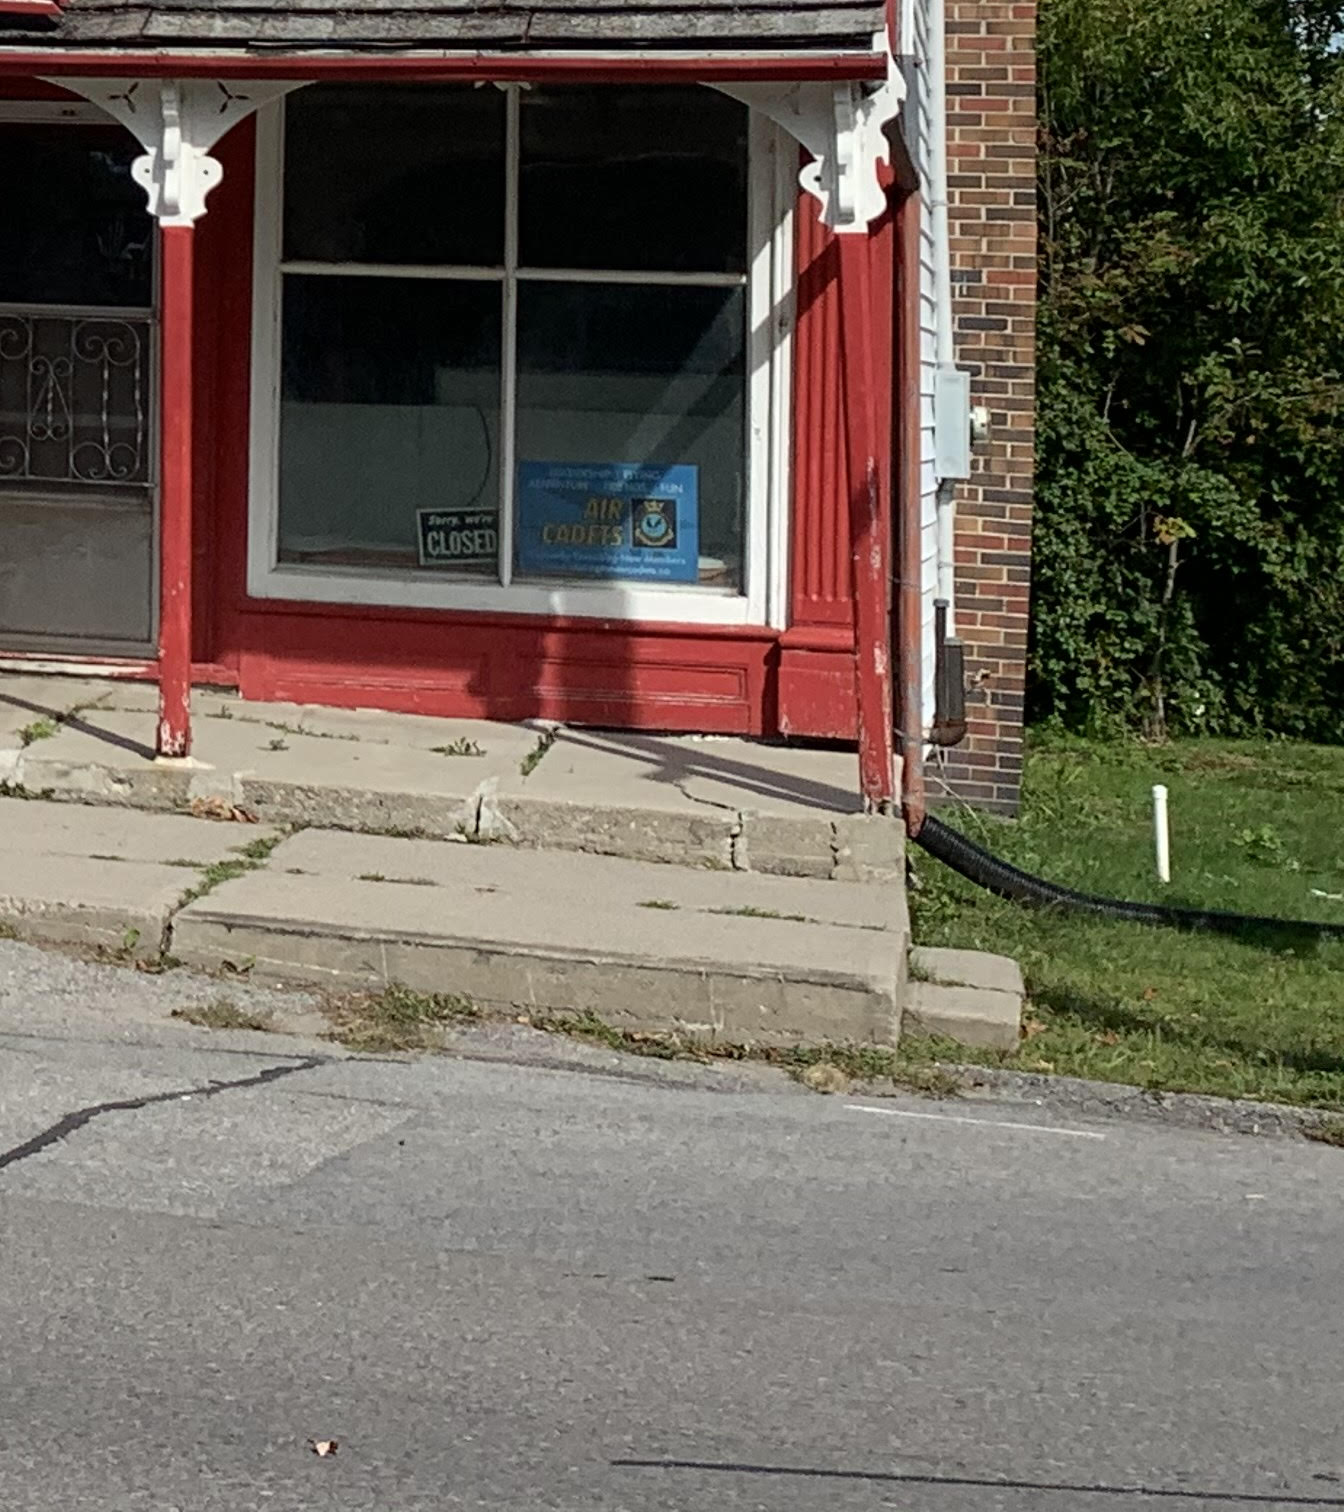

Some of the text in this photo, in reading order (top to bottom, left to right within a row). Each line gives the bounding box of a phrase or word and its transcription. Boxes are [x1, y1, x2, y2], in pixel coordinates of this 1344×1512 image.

[583, 497, 624, 521] AIR
[426, 528, 498, 557] CLOSED
[542, 524, 624, 547] CADETS
